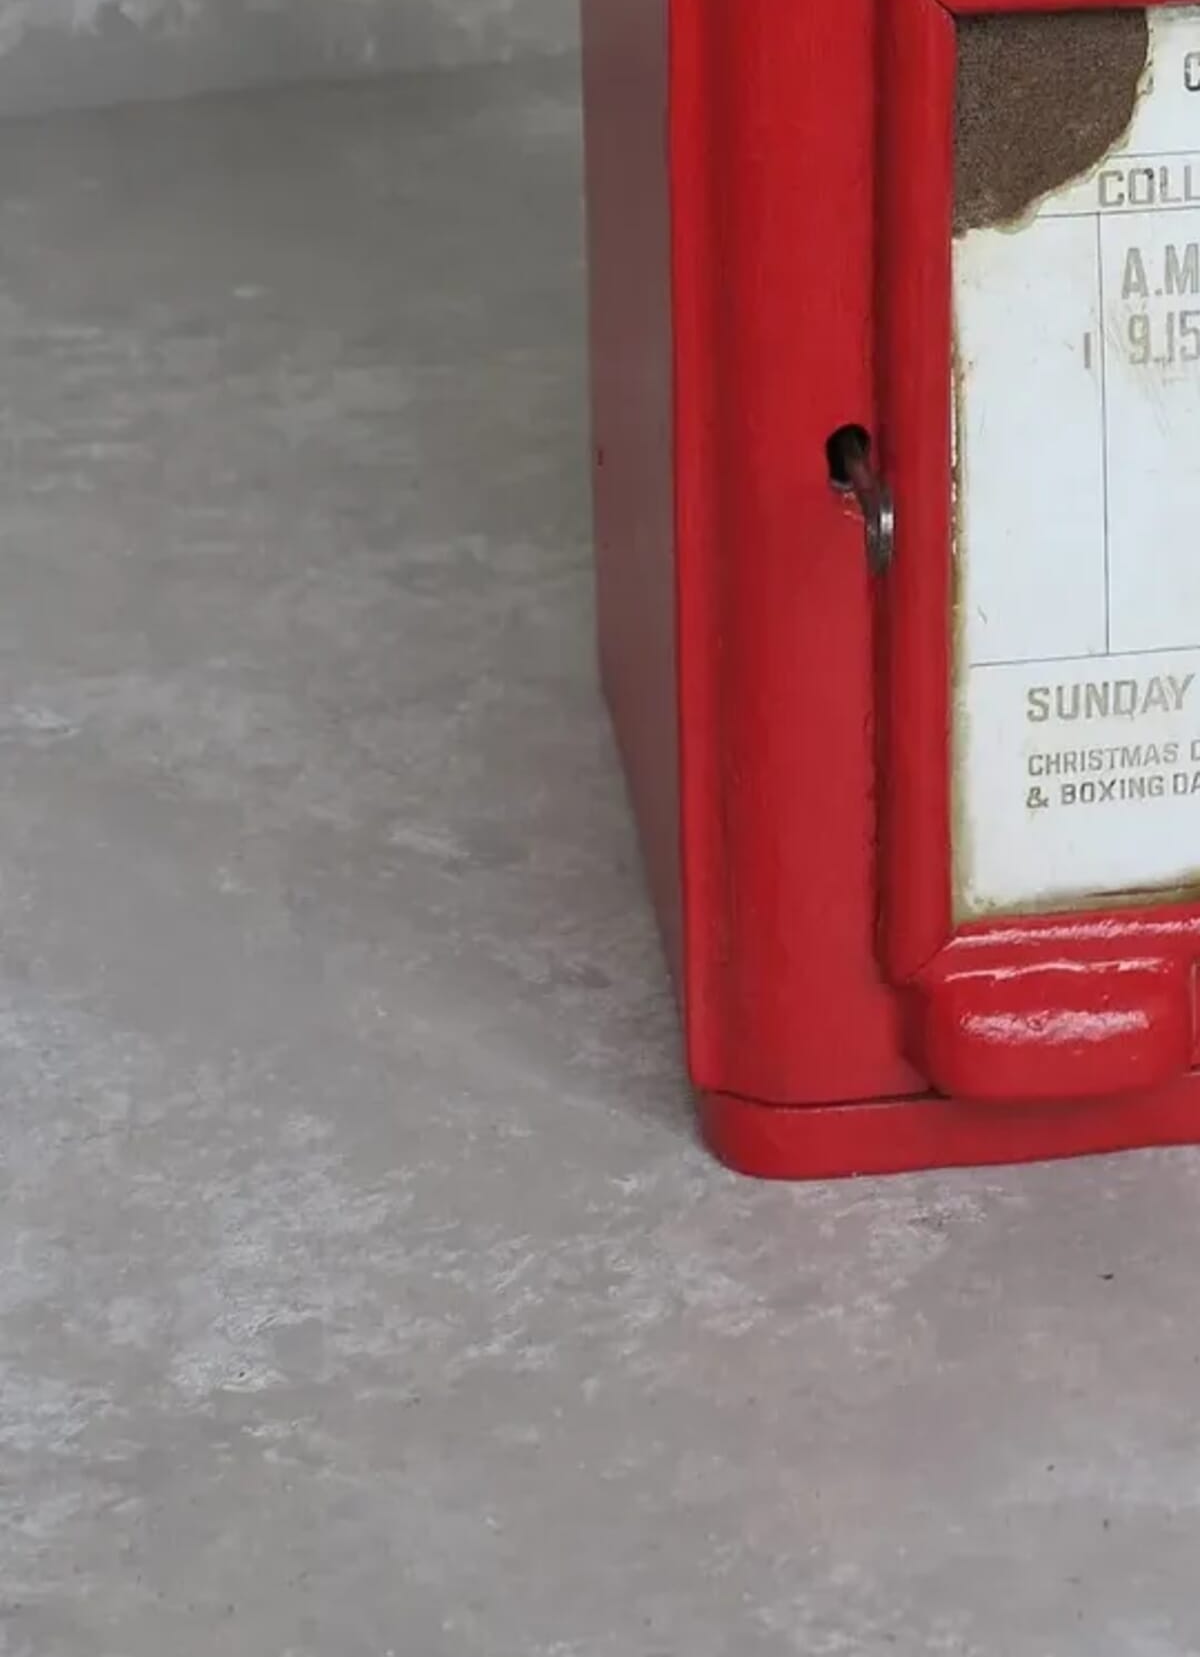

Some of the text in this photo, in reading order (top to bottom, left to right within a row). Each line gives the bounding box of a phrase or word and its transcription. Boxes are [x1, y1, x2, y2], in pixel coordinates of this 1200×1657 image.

[1025, 672, 1196, 723] SUNDAY
[1027, 741, 1179, 777] CHRISTMAS
[1025, 786, 1049, 810] &
[1059, 777, 1165, 806] BOXING
